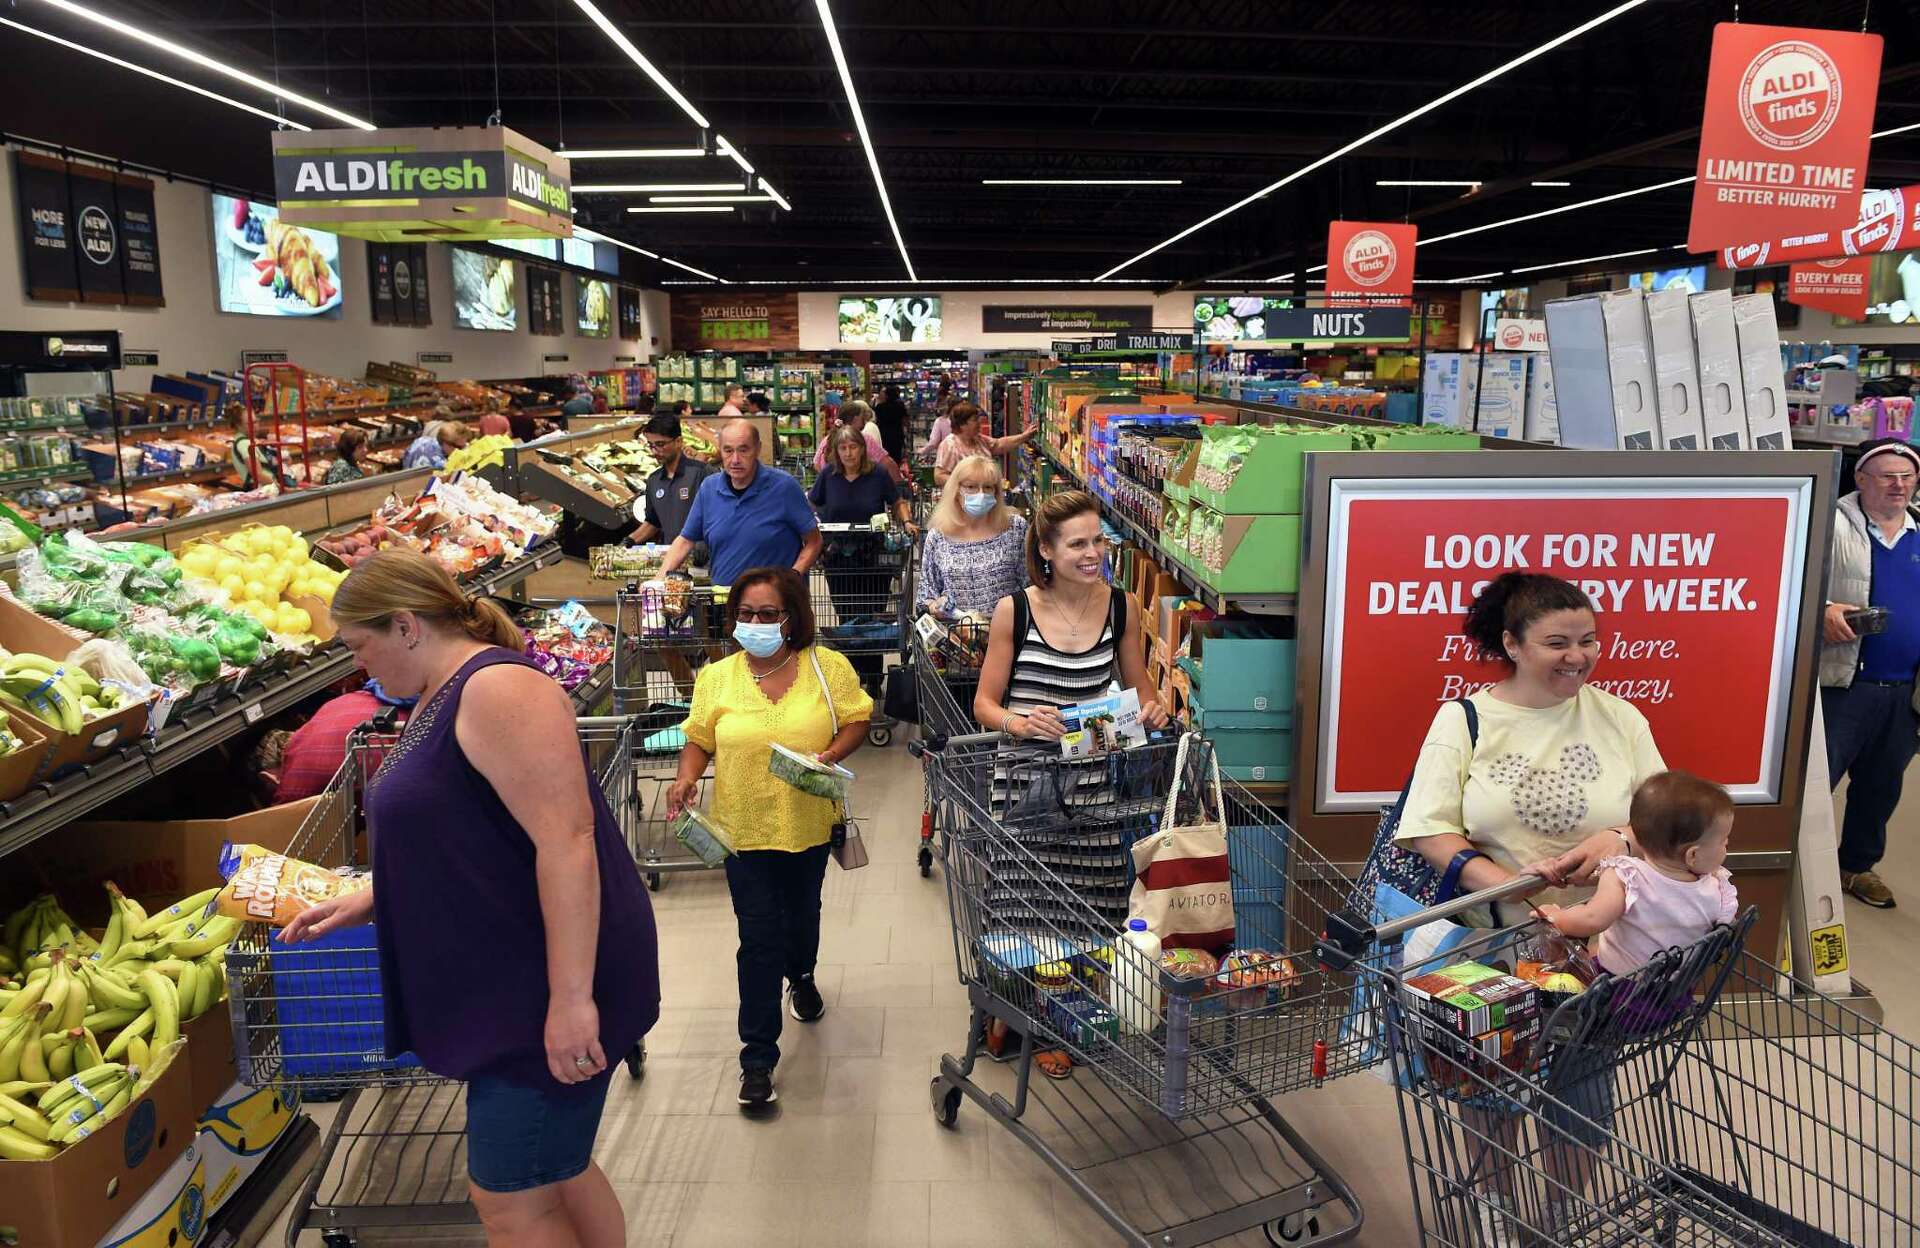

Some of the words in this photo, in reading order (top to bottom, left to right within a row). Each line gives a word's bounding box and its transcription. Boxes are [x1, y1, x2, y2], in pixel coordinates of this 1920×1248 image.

[1762, 70, 1816, 97] ALDI
[1767, 98, 1817, 124] finds
[294, 158, 487, 193] ALDIfresh
[1705, 158, 1795, 185] LIMITED
[1802, 164, 1856, 189] TIME
[1717, 187, 1773, 206] BETTER
[1777, 191, 1837, 209] HURRY!
[1860, 199, 1888, 222] LDI
[84, 215, 108, 231] NEW
[1858, 220, 1890, 247] finds
[86, 238, 111, 253] ALDI
[1355, 245, 1383, 259] ALDI
[1358, 256, 1385, 273] finds
[1794, 271, 1831, 284] EVERY
[1832, 273, 1864, 285] WEEK
[701, 305, 720, 319] SAY
[722, 306, 752, 318] HELLO
[755, 306, 769, 318] TO
[701, 322, 769, 339] FRESH
[1051, 319, 1091, 329] impossibly
[1312, 313, 1365, 337] NUTS
[1127, 335, 1158, 350] TRAIL
[1159, 334, 1182, 350] MIX
[1528, 331, 1546, 343] NE
[1423, 533, 1530, 569] LOOK
[1541, 532, 1617, 568] FOR
[1629, 531, 1716, 567] NEW
[1643, 577, 1758, 612] WEEK.
[1608, 631, 1680, 660] here.
